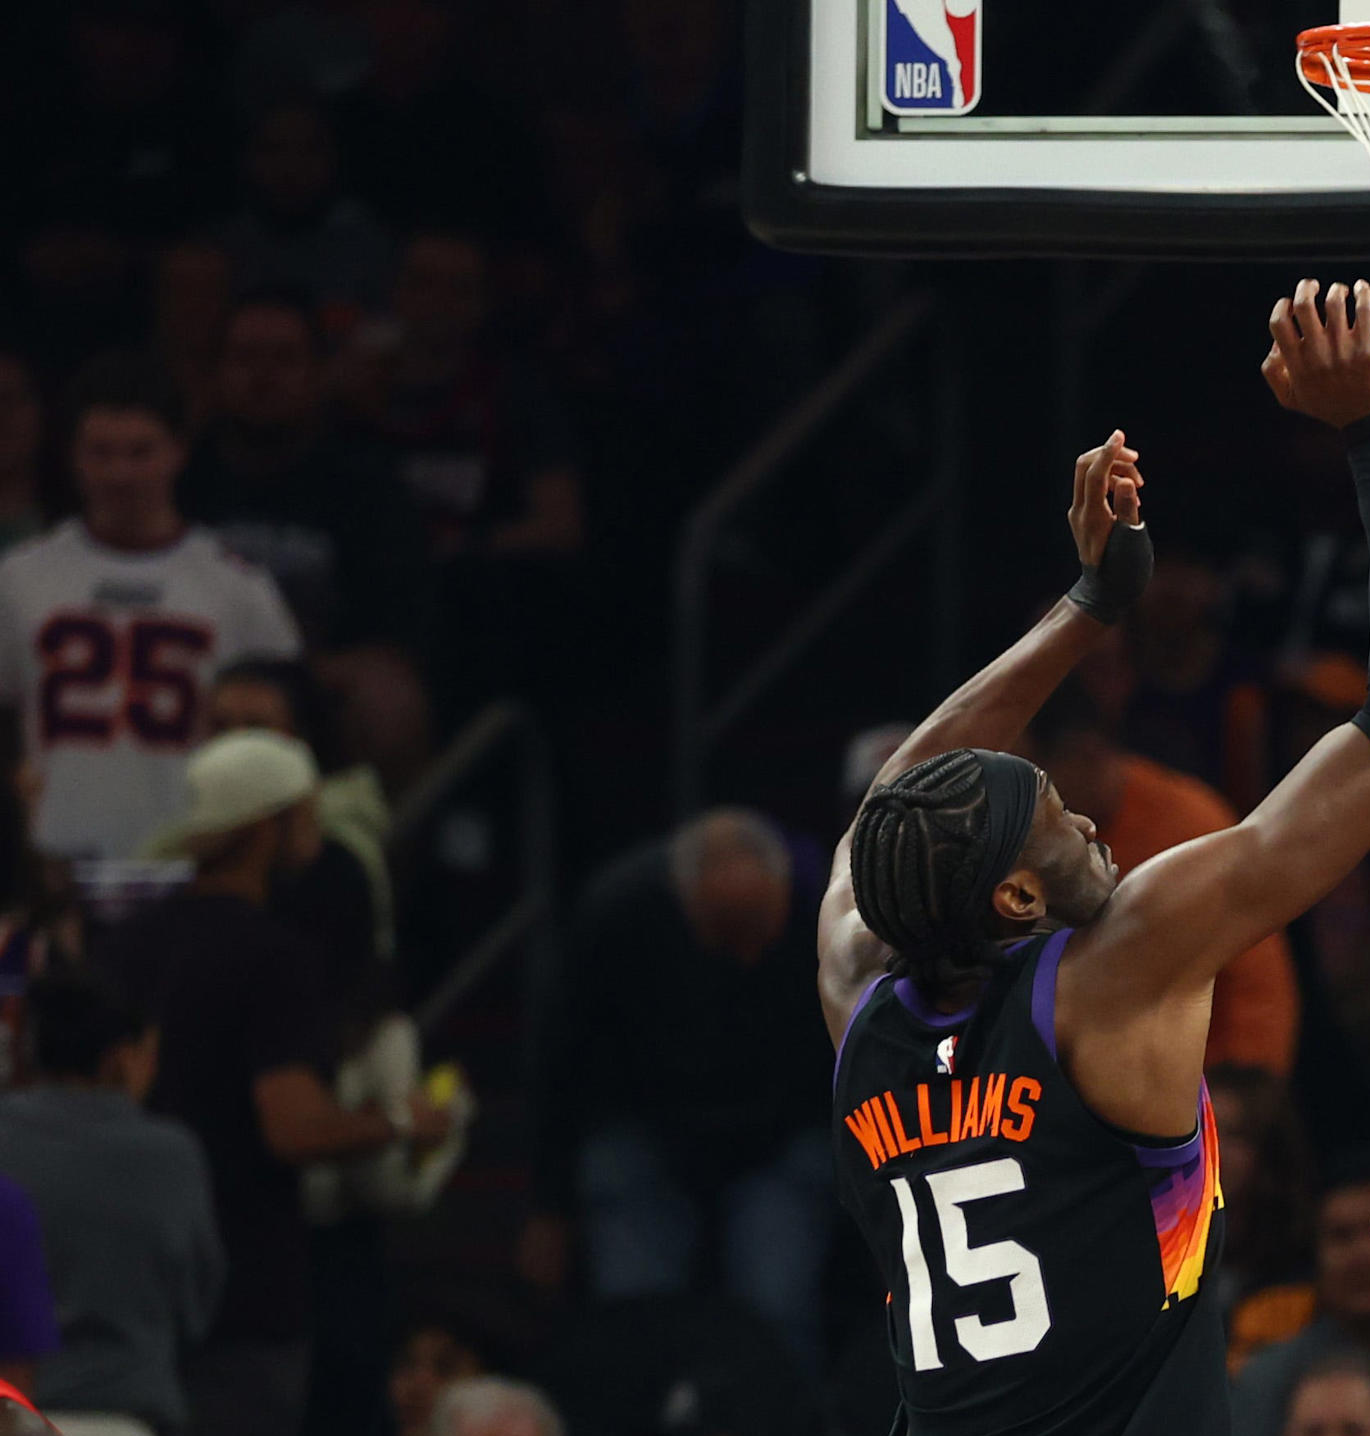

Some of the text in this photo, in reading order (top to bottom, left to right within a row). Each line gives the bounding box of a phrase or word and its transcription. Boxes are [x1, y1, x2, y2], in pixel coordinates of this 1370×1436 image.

[895, 62, 942, 99] NBA
[36, 608, 216, 753] 25
[844, 1072, 1042, 1171] WILLIAMS
[889, 1157, 1052, 1372] 15
